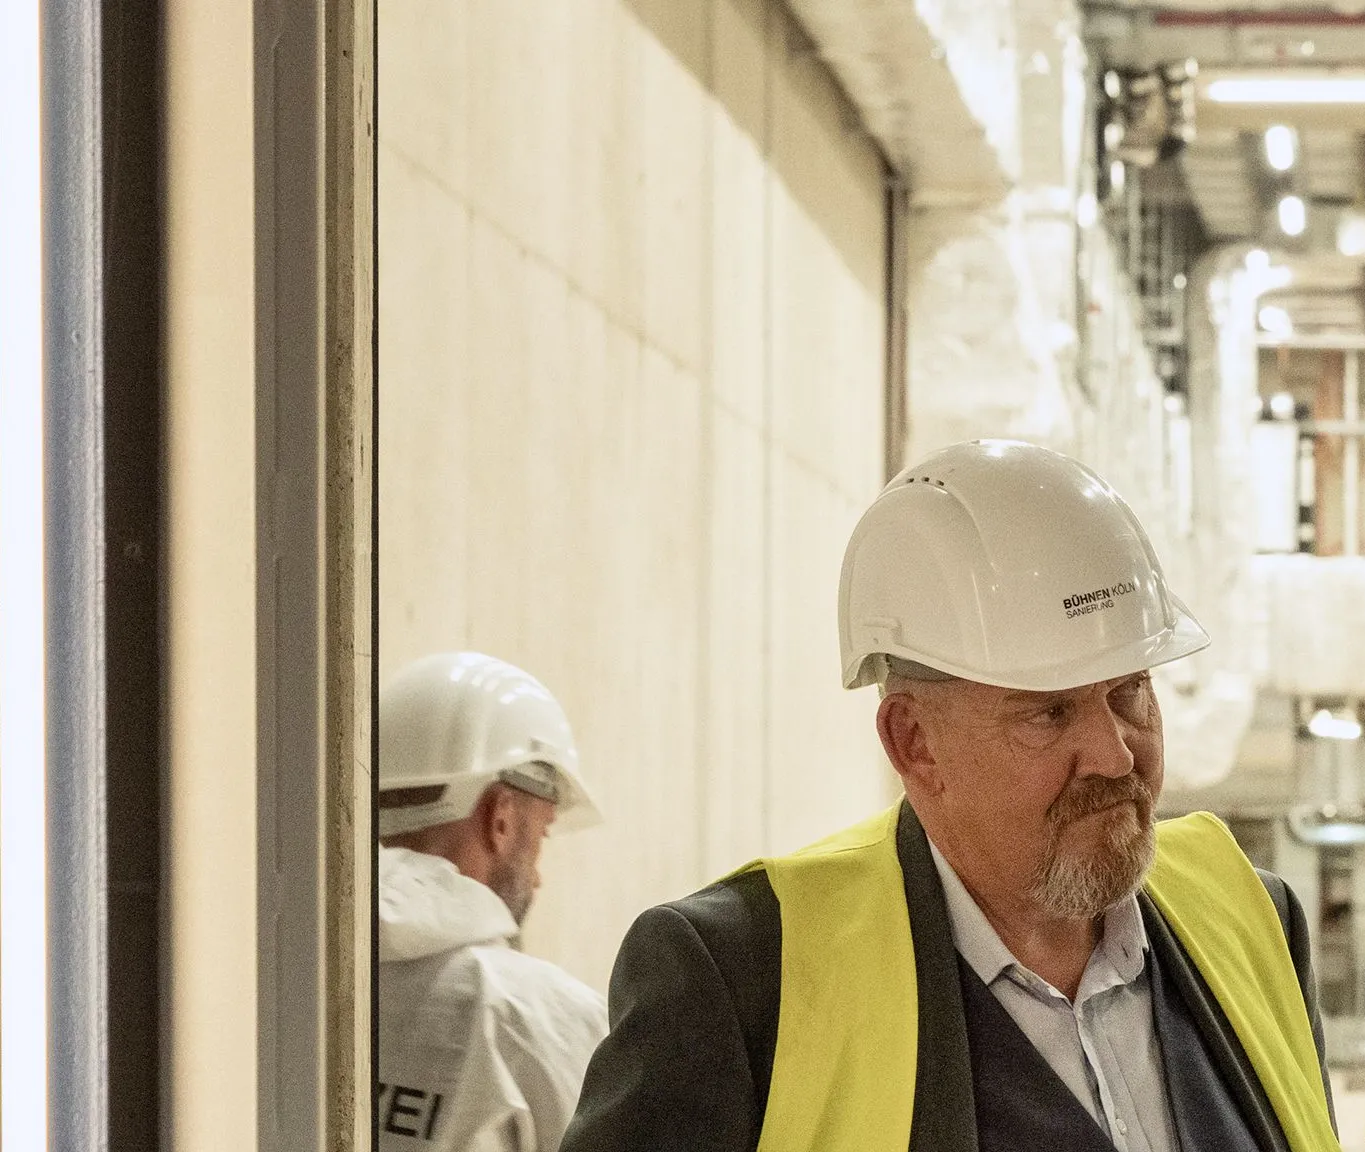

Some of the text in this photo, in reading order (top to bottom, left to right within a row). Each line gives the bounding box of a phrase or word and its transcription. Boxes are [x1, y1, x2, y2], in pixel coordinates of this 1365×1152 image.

[1063, 582, 1136, 609] BÜHNEN KÖLN
[1066, 599, 1115, 619] SANIERUNG
